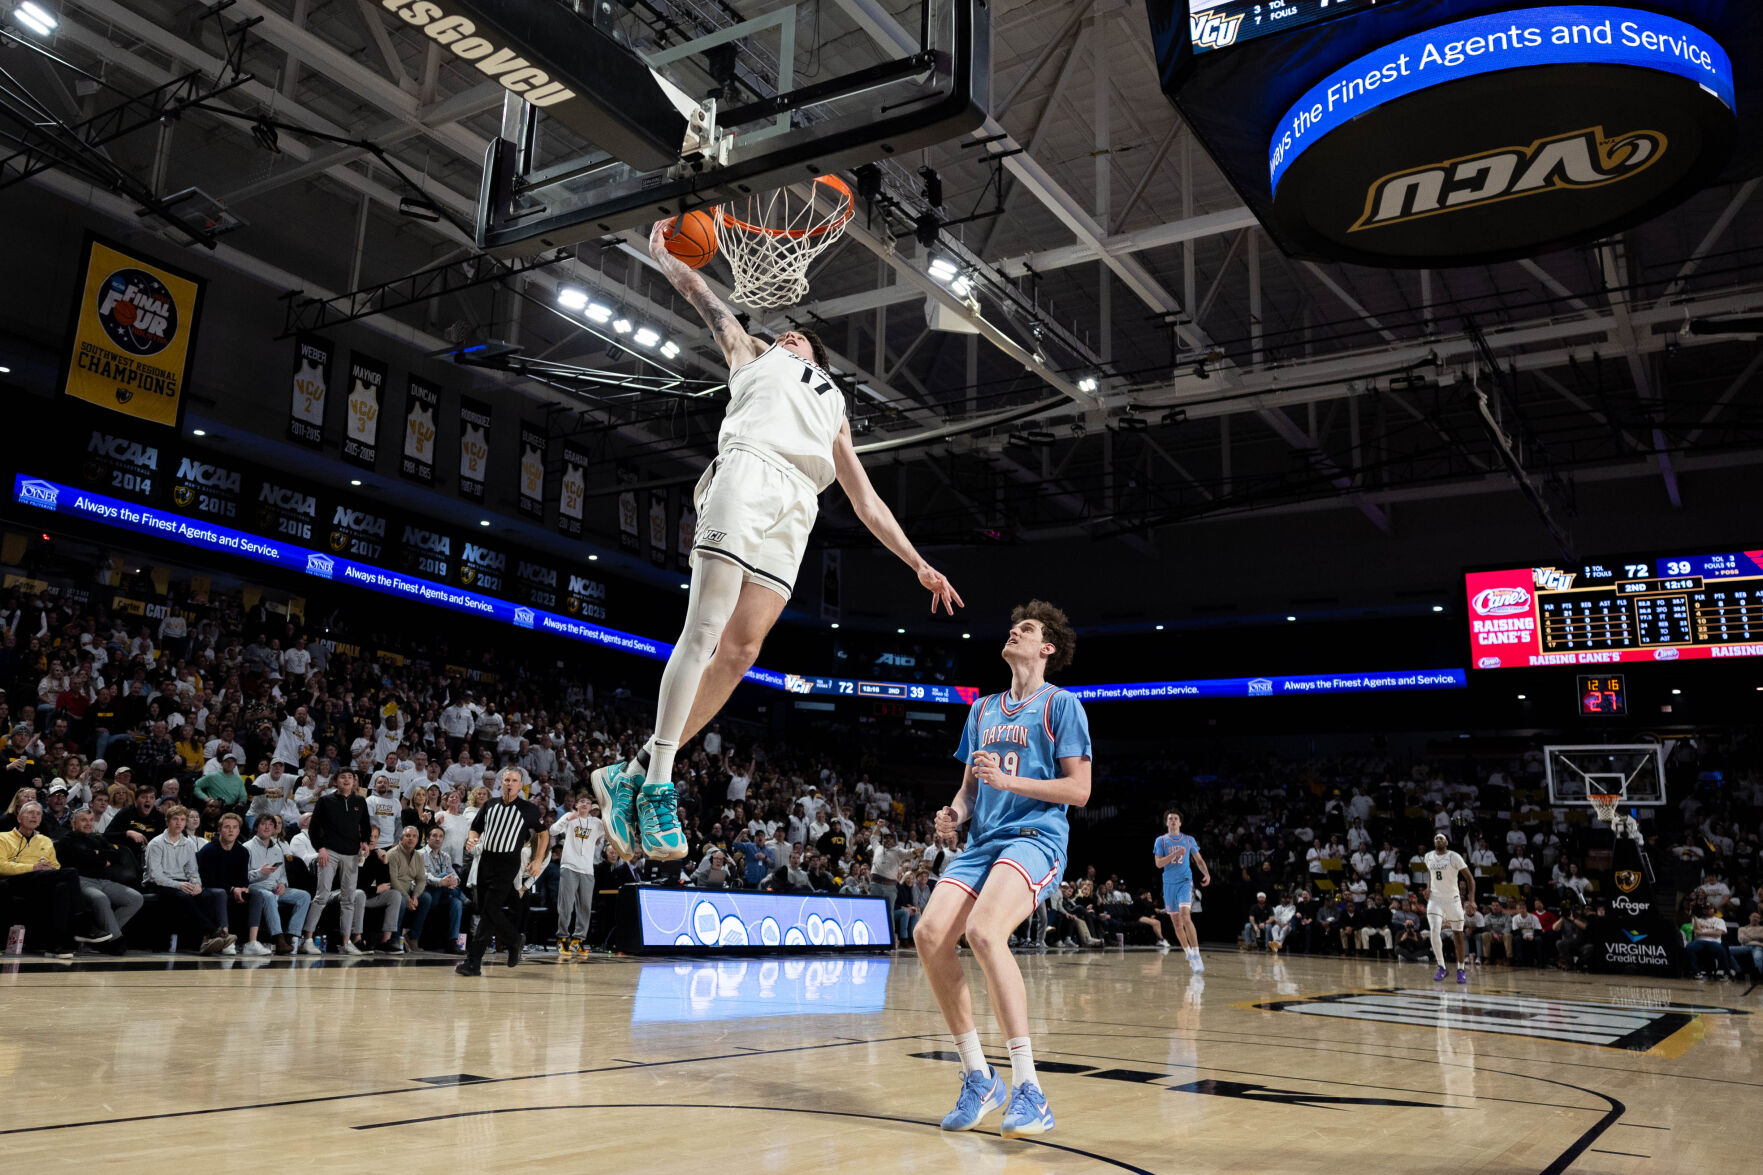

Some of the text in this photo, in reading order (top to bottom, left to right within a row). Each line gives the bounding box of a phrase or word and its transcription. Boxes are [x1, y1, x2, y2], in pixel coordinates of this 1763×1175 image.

[1254, 5, 1261, 14] 3
[1254, 6, 1298, 25] 7 FOULS
[1190, 10, 1245, 49] VCU
[1292, 104, 1323, 137] the
[1327, 53, 1411, 113] Finest
[1419, 23, 1542, 70] Agents
[1551, 20, 1612, 44] and
[1620, 21, 1717, 74] Service.
[1372, 136, 1614, 222] VCU
[122, 284, 170, 318] FINAL
[80, 342, 176, 381] SOUTHWEST REGIONAL
[301, 344, 327, 364] WEBER
[78, 351, 176, 397] CHAMPIONS
[352, 364, 382, 385] MAYNOR
[800, 366, 832, 396] 17
[296, 379, 323, 400] VCU
[410, 384, 437, 405] DUNCAN
[304, 398, 312, 413] 2
[350, 400, 376, 421] VCU
[357, 418, 366, 432] 3
[408, 420, 434, 442] VCU
[88, 430, 158, 470] NCAA
[416, 438, 424, 453] 5
[463, 442, 486, 460] VCU
[470, 458, 478, 472] 12
[563, 448, 589, 467] GRAHAM
[112, 470, 152, 496] 2014
[176, 456, 242, 494] NCAA
[20, 486, 57, 504] JOYNER
[258, 482, 317, 518] NCAA
[567, 496, 576, 509] 21
[198, 494, 238, 518] 2015
[74, 496, 118, 518] Always
[120, 508, 140, 524] the
[142, 513, 177, 533] Finest
[178, 522, 217, 543] Agents
[218, 534, 238, 548] and
[240, 538, 280, 558] Service.
[278, 516, 312, 540] 2016
[332, 505, 386, 538] NCAA
[350, 538, 382, 560] 2017
[401, 524, 451, 556] NCAA
[307, 560, 333, 574] JOYNER
[418, 556, 448, 577] 2019
[461, 542, 506, 572] NCAA
[516, 560, 558, 588] NCAA
[1532, 567, 1577, 590] VCU
[1624, 564, 1649, 578] 72
[1667, 562, 1691, 575] 39
[344, 566, 376, 584] Always
[377, 574, 392, 587] the
[392, 578, 419, 594] Finest
[420, 585, 448, 601] Agents
[448, 595, 464, 606] and
[464, 596, 494, 614] Service.
[476, 573, 502, 592] 2021
[568, 574, 606, 600] NCAA
[1624, 580, 1694, 592] 2ND 12:16
[530, 590, 557, 608] 2023
[1473, 617, 1534, 632] RAISING
[544, 616, 567, 632] Always
[568, 622, 579, 634] the
[579, 624, 599, 640] Finest
[600, 633, 622, 646] Agents
[622, 638, 632, 648] and
[634, 640, 656, 654] Service.
[1478, 630, 1532, 645] CANE'S
[874, 652, 916, 668] A10
[1529, 652, 1622, 666] RAISING CANE'S
[1711, 644, 1763, 657] RAISING
[765, 674, 784, 686] Service.
[838, 682, 854, 694] 72
[1284, 674, 1456, 692] Always the Finest Agents and Service.
[1588, 680, 1619, 691] 12 16
[910, 686, 924, 698] 39
[1083, 688, 1096, 698] the
[1097, 688, 1120, 698] Finest
[1122, 688, 1150, 698] Agents
[1151, 687, 1166, 696] and
[1167, 686, 1200, 695] Service.
[1590, 691, 1616, 712] 27
[981, 724, 1028, 749] DAYTON
[1436, 871, 1442, 880] 8
[1612, 896, 1650, 916] Kroger
[1605, 942, 1667, 957] VIRGINIA
[1605, 953, 1668, 965] Credit Union
